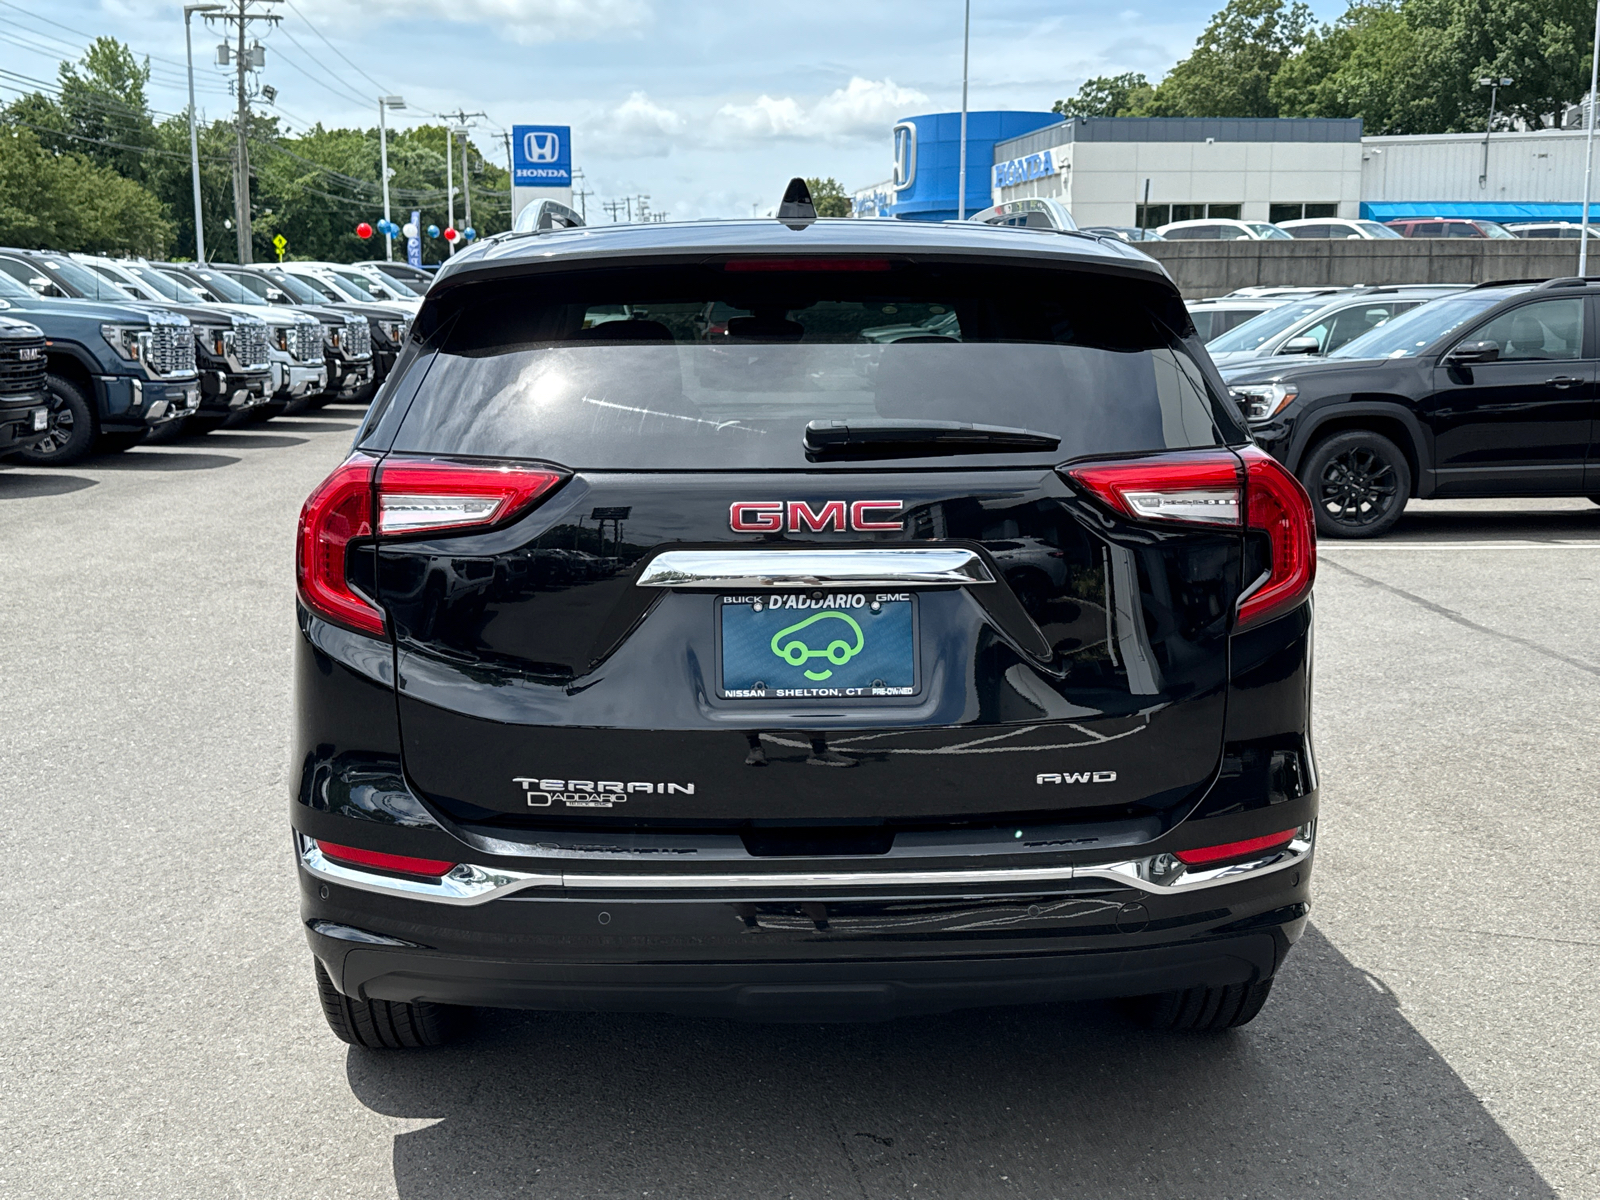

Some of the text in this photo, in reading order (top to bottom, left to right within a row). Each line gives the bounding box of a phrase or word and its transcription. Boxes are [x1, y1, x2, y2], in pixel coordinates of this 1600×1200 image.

[516, 168, 569, 178] HONDA
[994, 150, 1055, 188] HONDA
[729, 500, 904, 533] GMC
[723, 596, 763, 604] BUICK
[768, 594, 866, 610] D'ADDARIO
[876, 593, 910, 602] GMC
[725, 689, 766, 698] NISSAN
[776, 687, 864, 697] SHELTON, CT
[1036, 771, 1117, 785] AWD
[512, 777, 695, 795] TERRAIN
[527, 791, 627, 807] D'ADDARIO
